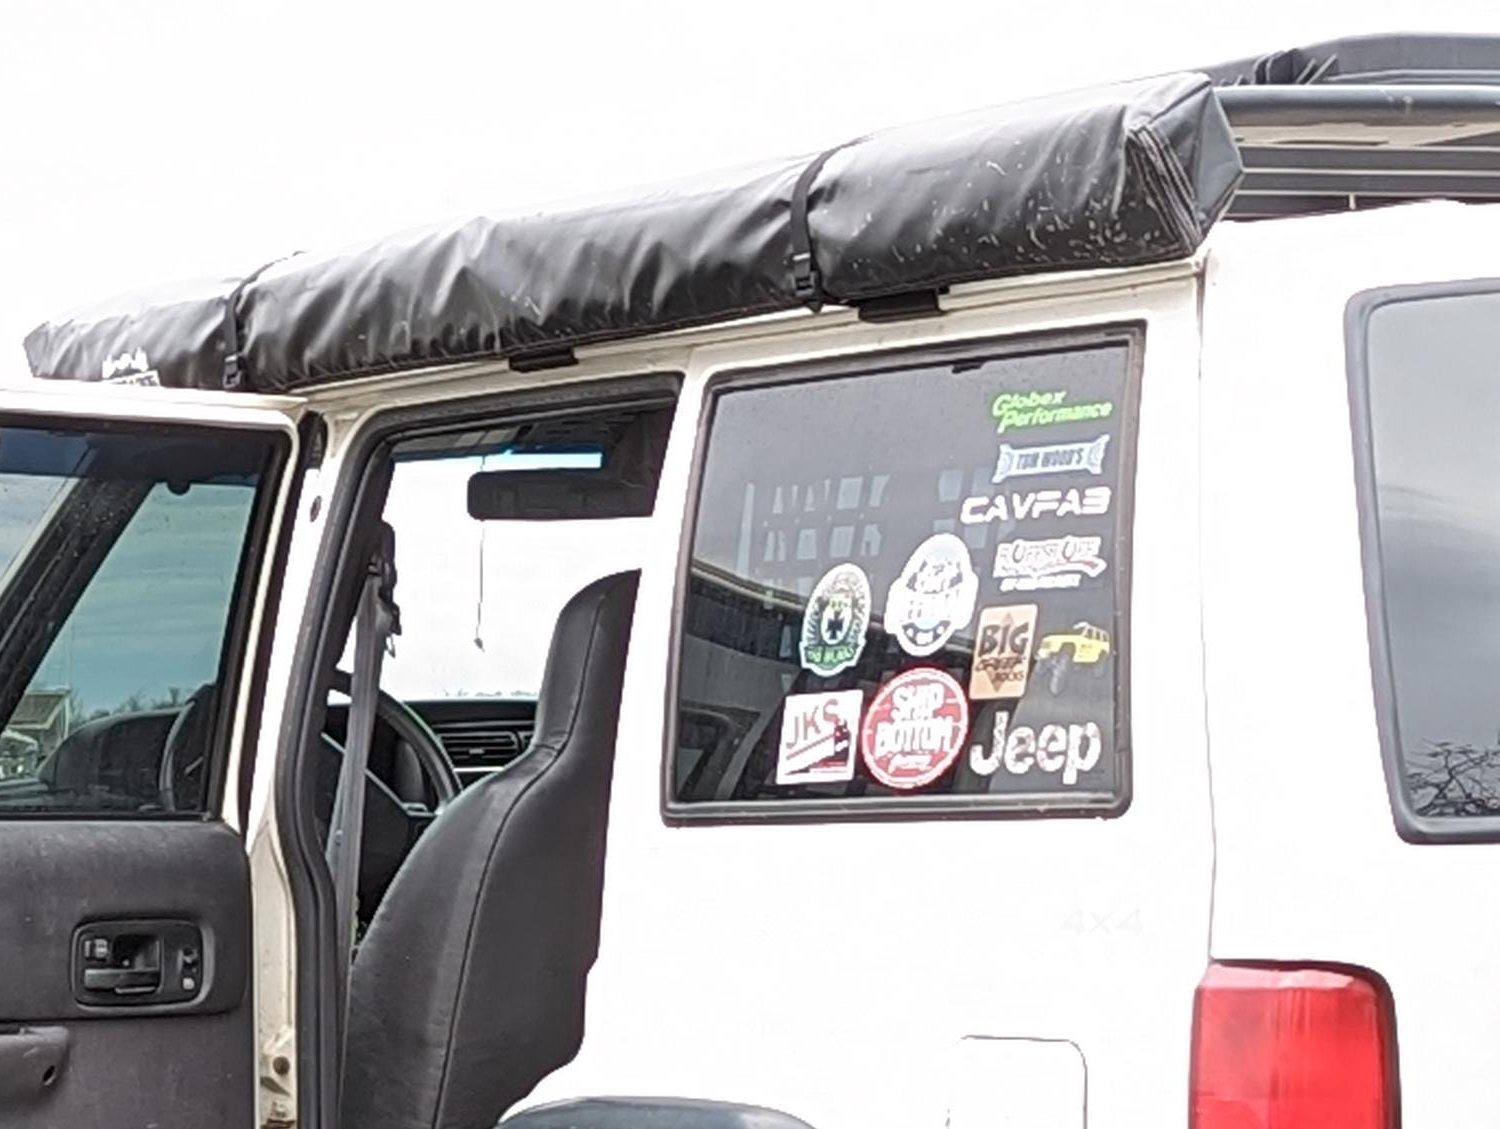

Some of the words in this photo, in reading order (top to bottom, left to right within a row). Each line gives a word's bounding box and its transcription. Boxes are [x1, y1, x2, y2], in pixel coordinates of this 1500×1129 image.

[996, 401, 1113, 434] Performance
[960, 486, 1112, 524] CAVFAB
[978, 623, 1030, 657] BIG
[786, 699, 839, 750] JKS
[969, 710, 1102, 786] Jeep
